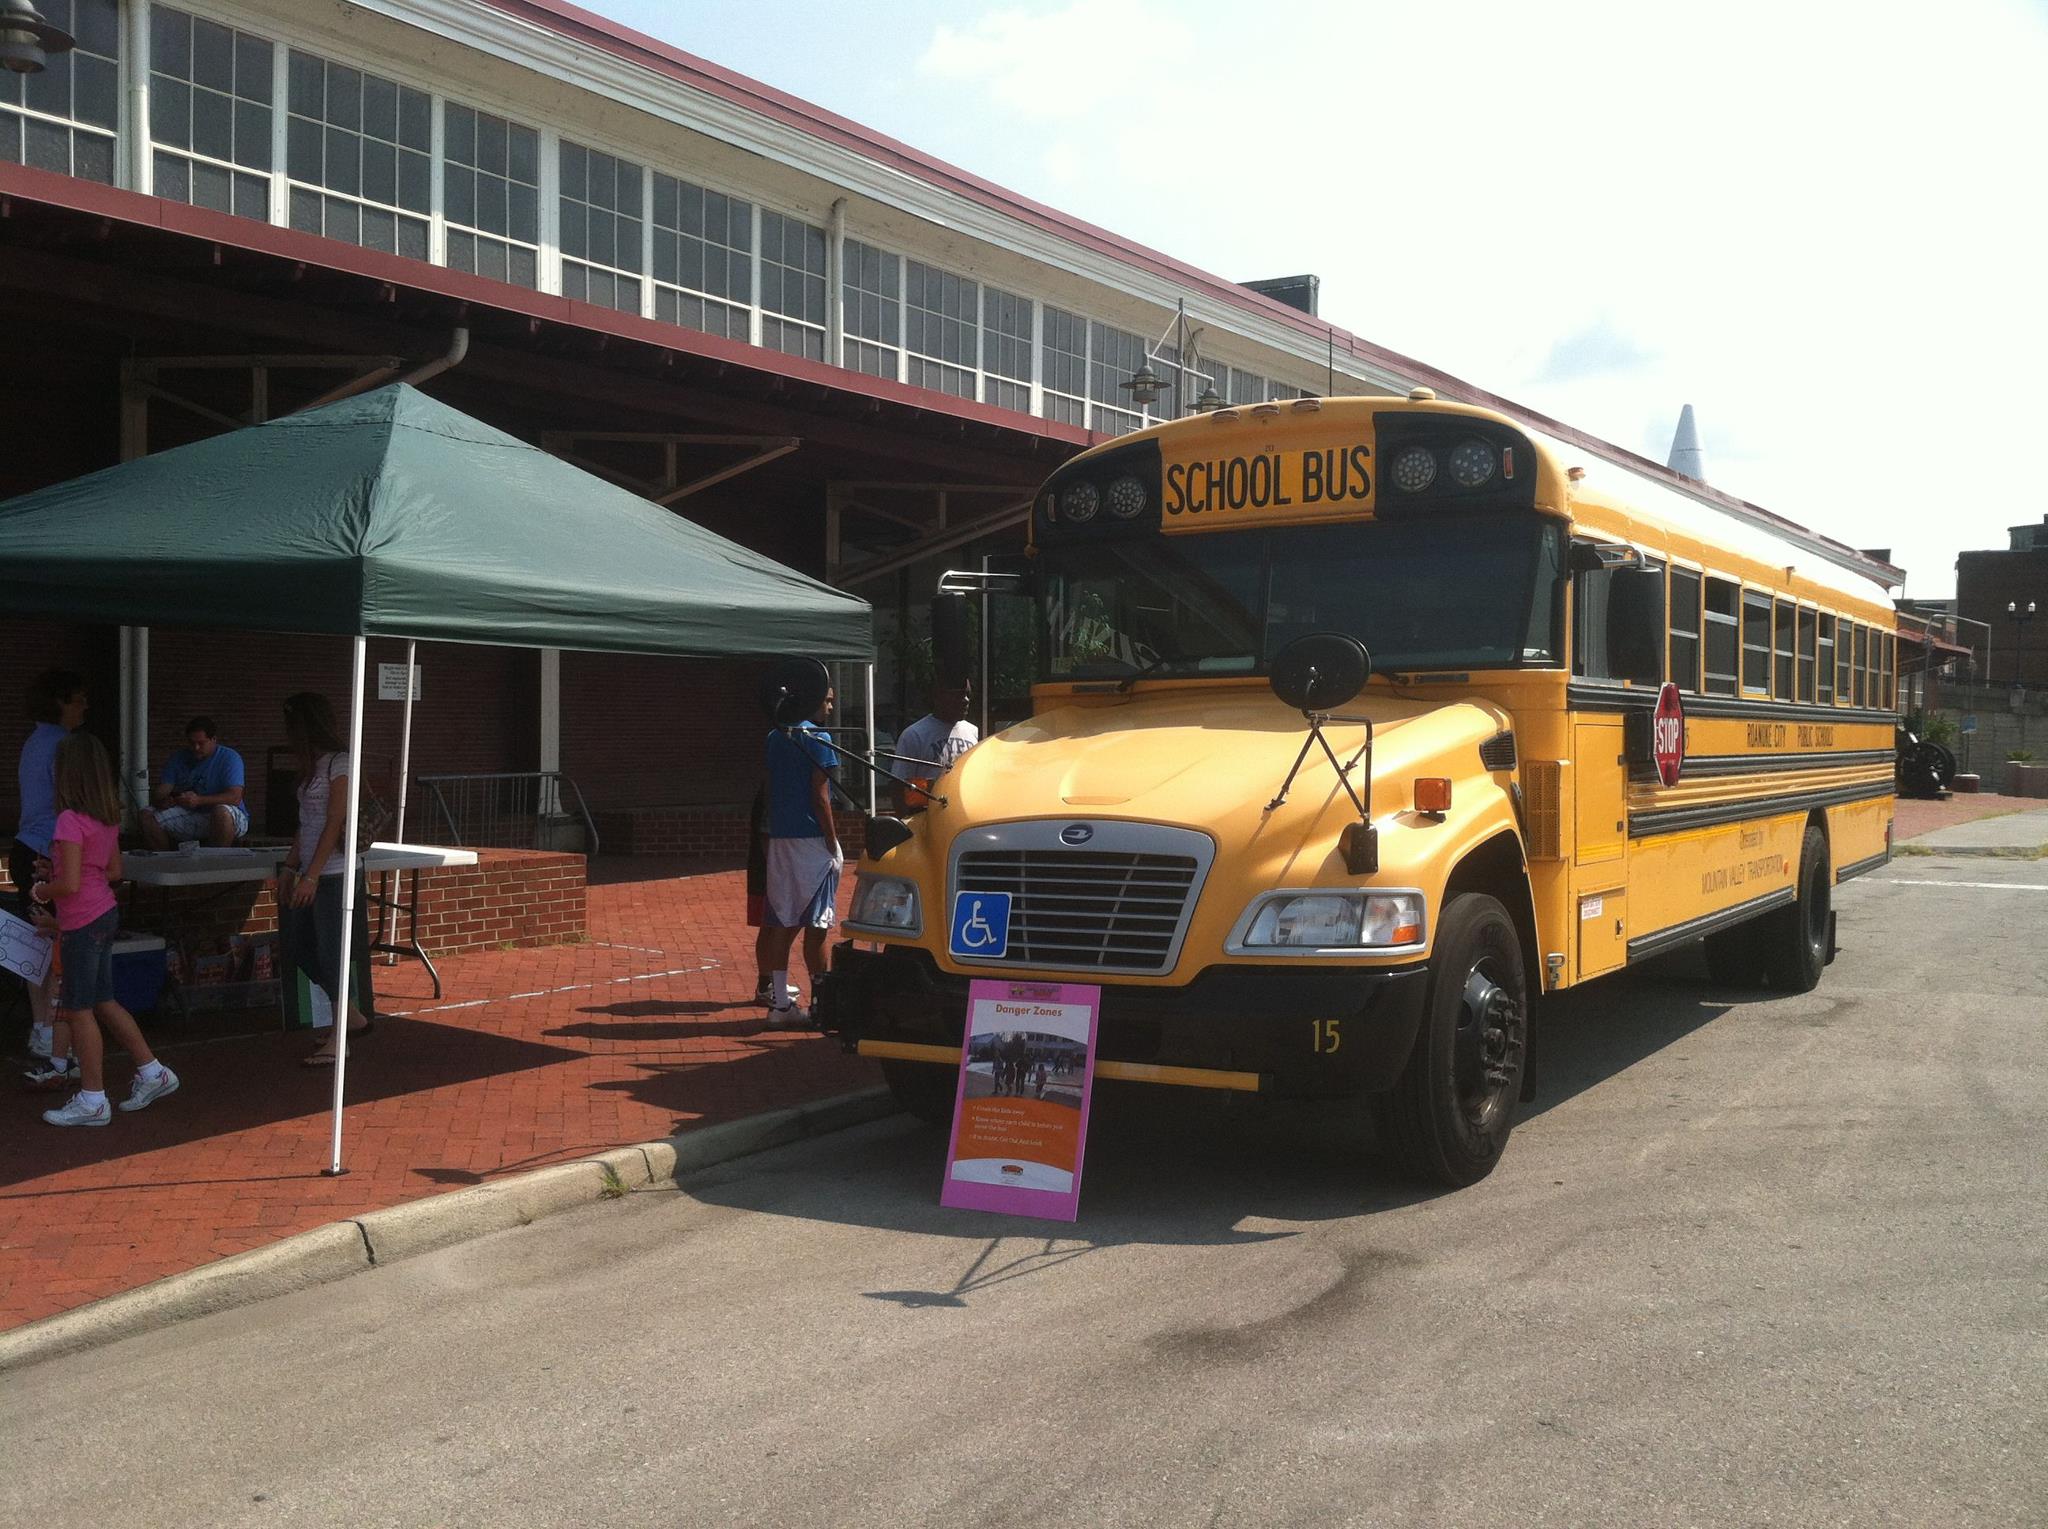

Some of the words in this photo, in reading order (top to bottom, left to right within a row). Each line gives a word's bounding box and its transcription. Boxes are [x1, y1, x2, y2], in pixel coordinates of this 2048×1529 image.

[1166, 454, 1291, 515] SCHOOL
[1302, 445, 1370, 503] BUS
[1658, 718, 1679, 754] STOP
[1774, 724, 1786, 748] CITY
[996, 1004, 1031, 1017] Danger
[1033, 1006, 1063, 1017] Zones
[1312, 1020, 1340, 1053] 15
